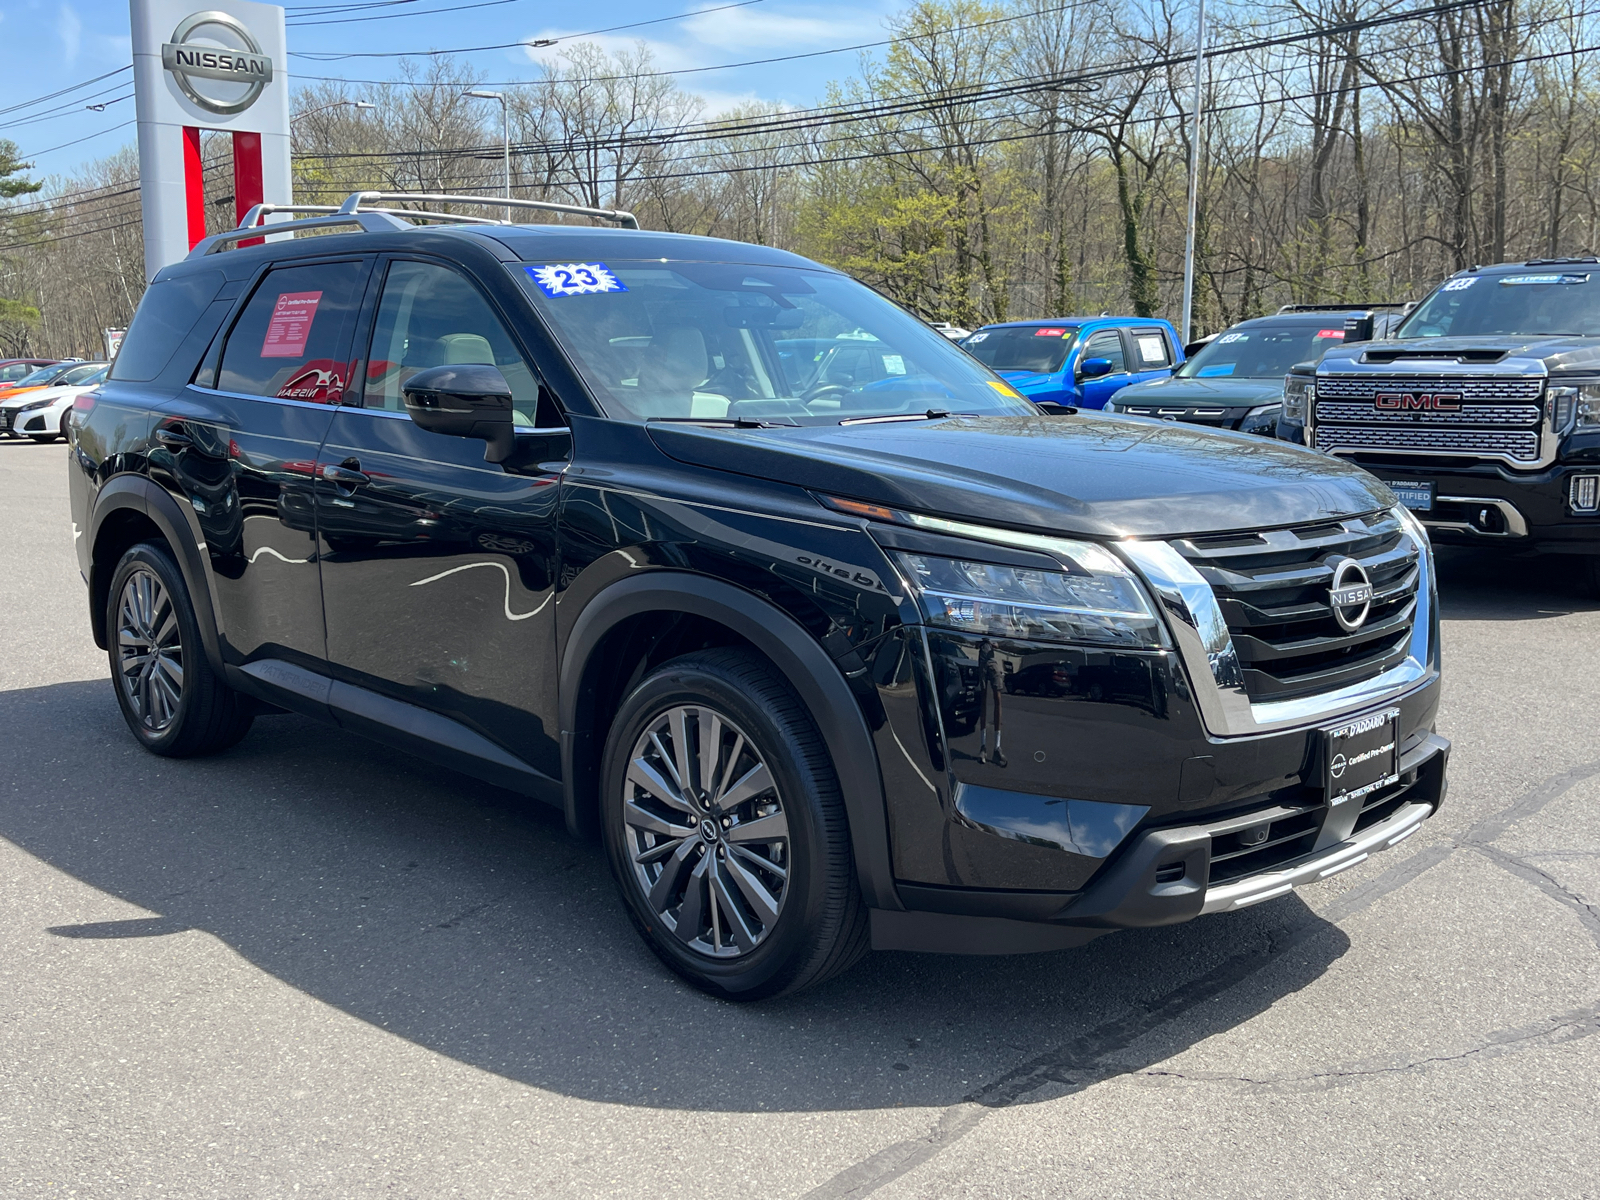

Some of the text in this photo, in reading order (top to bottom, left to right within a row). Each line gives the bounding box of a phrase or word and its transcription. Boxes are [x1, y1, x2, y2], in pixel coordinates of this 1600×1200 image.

[176, 50, 265, 76] NISSAN
[554, 268, 599, 288] 23
[1375, 393, 1461, 410] GMC
[1394, 492, 1430, 500] RTIFIED
[1332, 588, 1373, 605] NISSAN
[259, 663, 328, 695] PATHFINDER
[1350, 715, 1385, 737] D'ADDARIO
[1348, 749, 1370, 766] Certified
